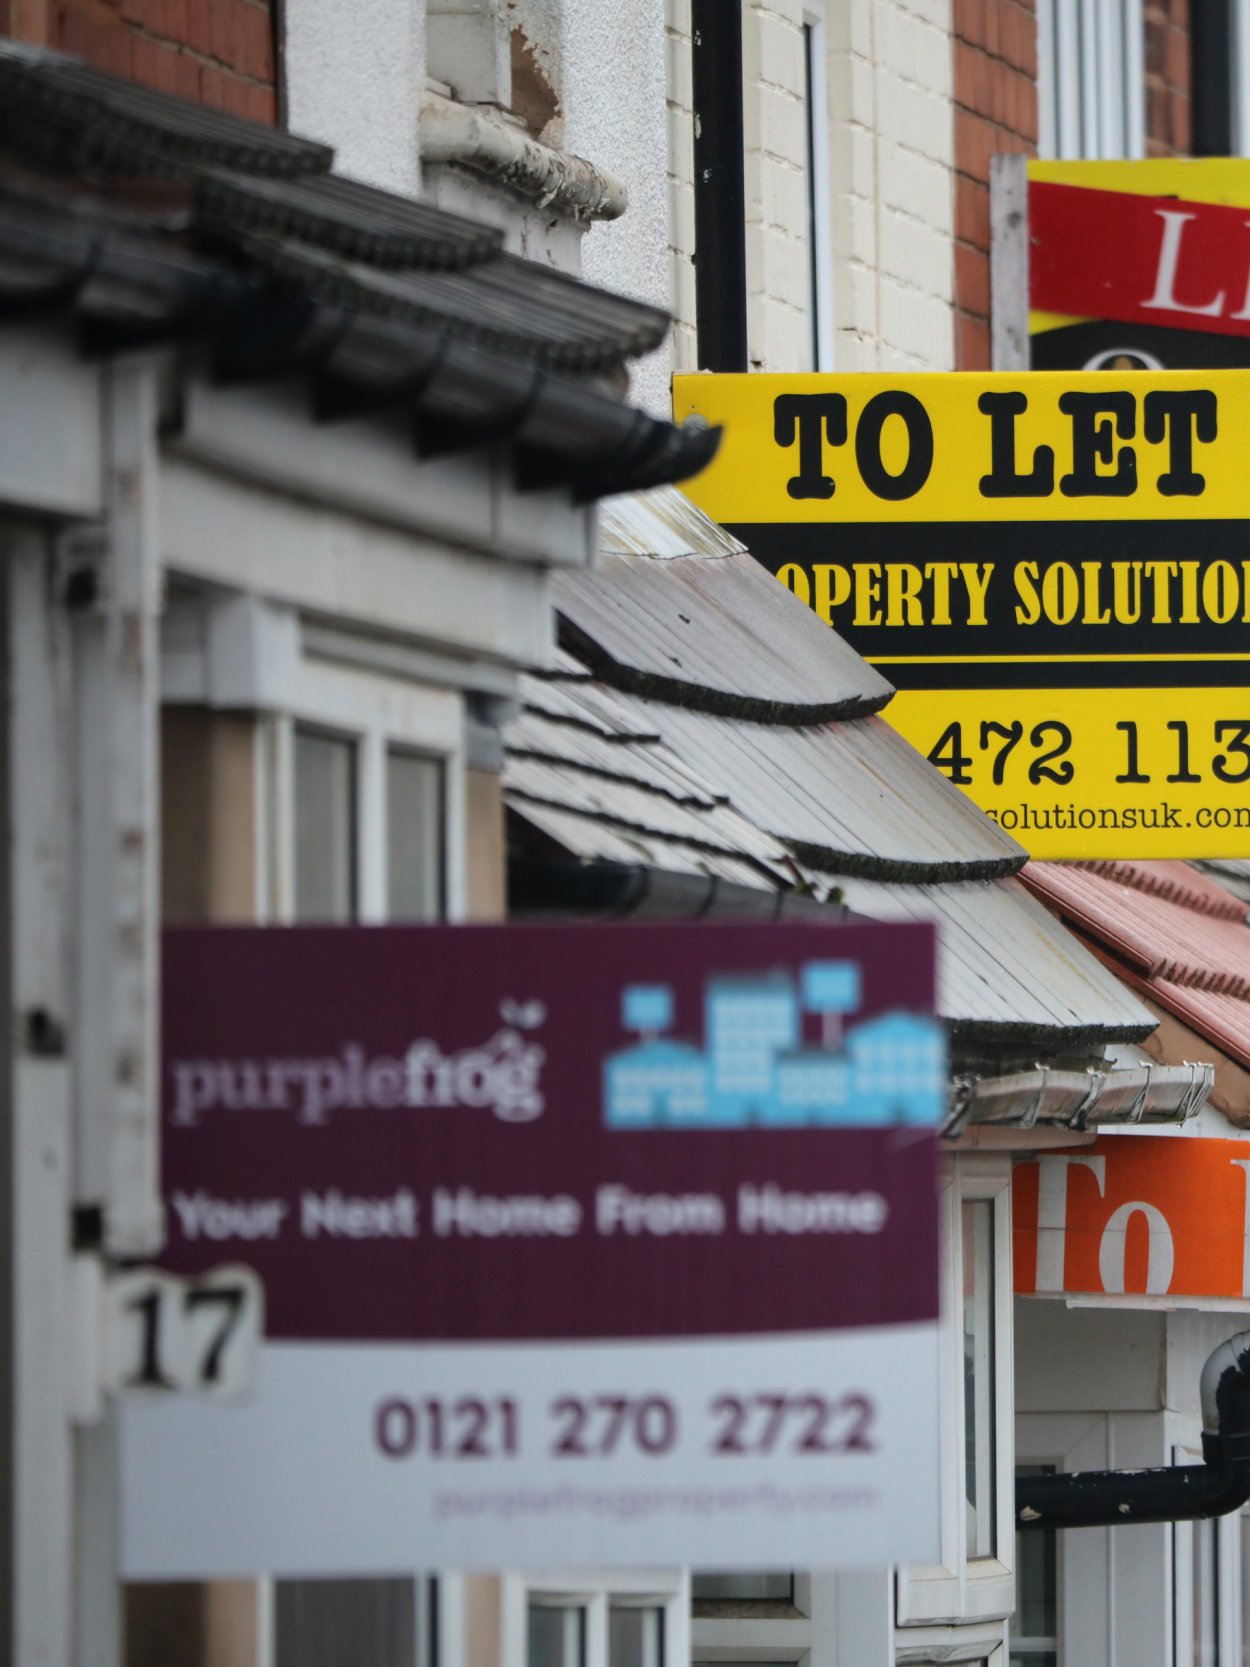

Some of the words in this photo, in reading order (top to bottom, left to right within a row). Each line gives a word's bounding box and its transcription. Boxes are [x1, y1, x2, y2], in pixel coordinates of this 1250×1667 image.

[773, 390, 934, 501] TO
[978, 389, 1218, 498] LET
[926, 720, 1075, 786] 472
[172, 1034, 546, 1128] purplefrog
[172, 1184, 289, 1242] Your
[301, 1184, 419, 1241] Next
[433, 1184, 581, 1239] Home
[596, 1183, 723, 1238] From
[738, 1182, 887, 1237] Home
[1013, 1154, 1175, 1296] To
[122, 1283, 250, 1392] 17
[373, 1393, 519, 1461] 0121
[549, 1393, 681, 1460] 270
[707, 1390, 880, 1458] 2722
